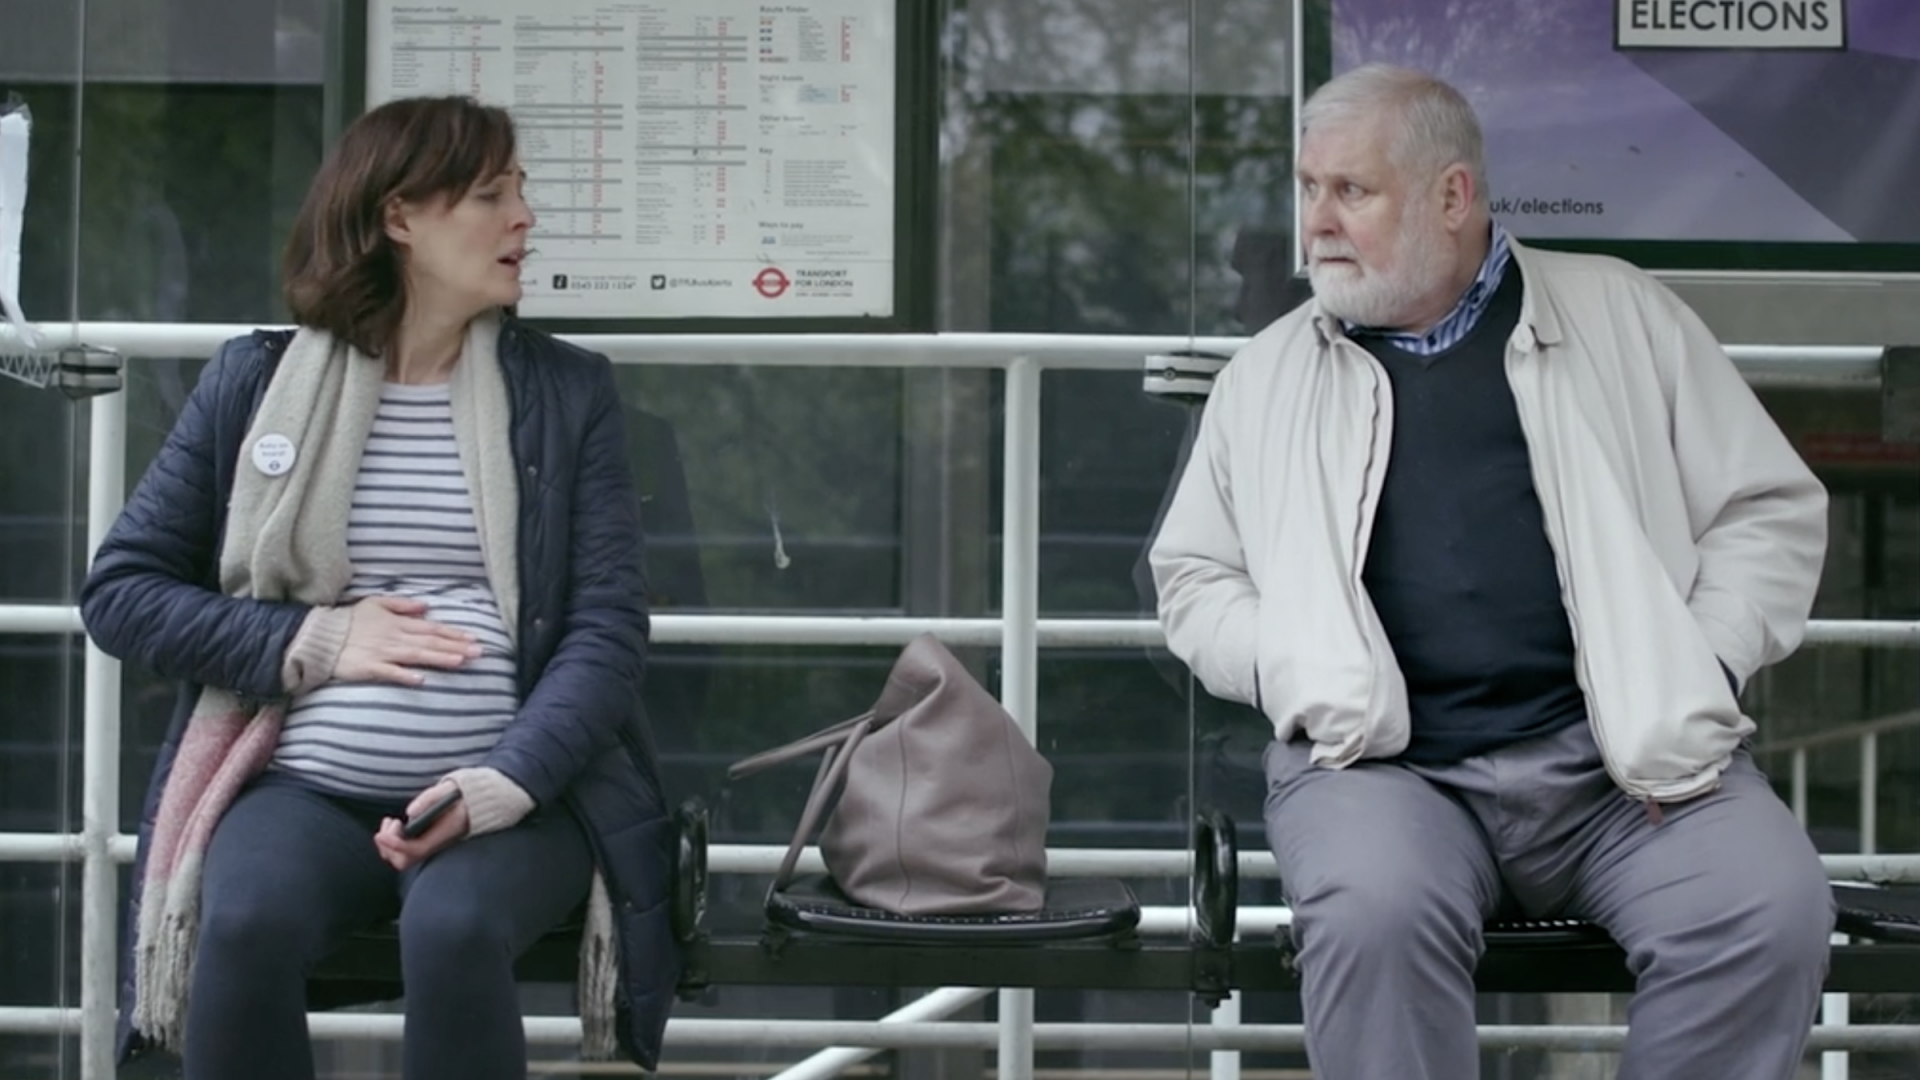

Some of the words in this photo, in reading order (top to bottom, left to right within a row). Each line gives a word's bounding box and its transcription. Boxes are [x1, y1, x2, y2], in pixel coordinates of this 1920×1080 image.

[1631, 0, 1829, 31] ELECTIONS
[759, 222, 778, 230] Ways
[791, 223, 804, 231] pay
